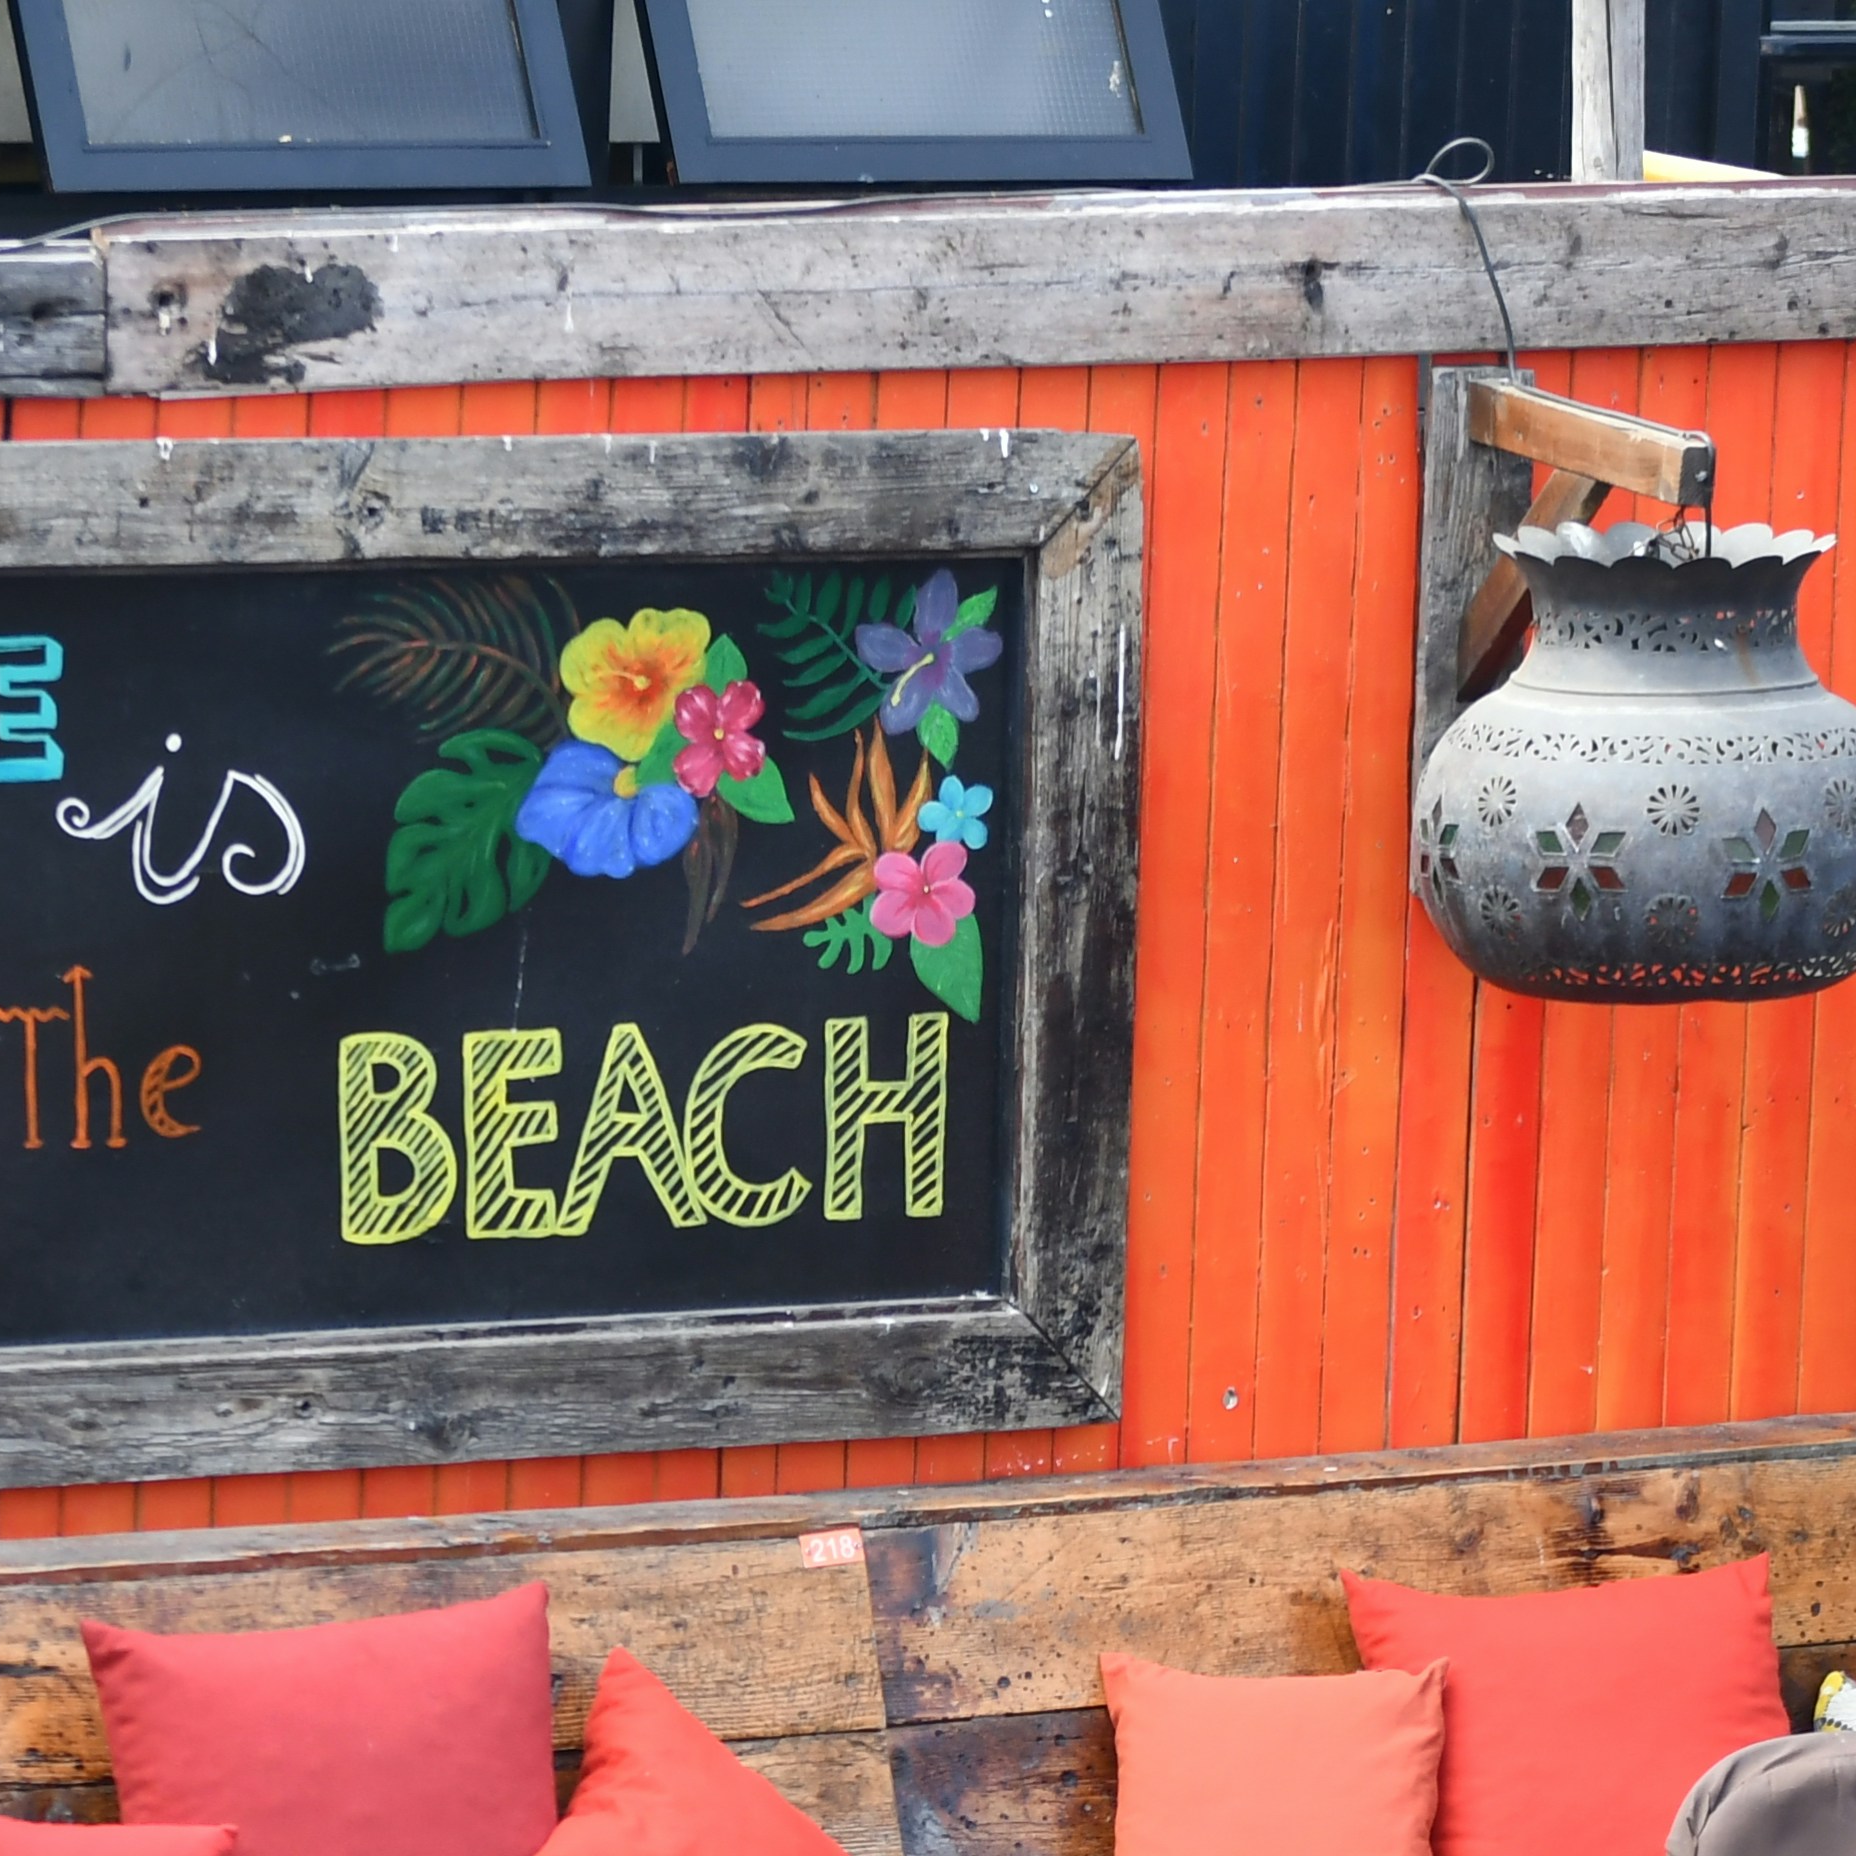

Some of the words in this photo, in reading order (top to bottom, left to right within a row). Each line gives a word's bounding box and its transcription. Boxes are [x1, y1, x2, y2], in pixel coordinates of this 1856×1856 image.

[54, 732, 307, 906] is
[338, 1010, 950, 1246] BEACH
[810, 1534, 855, 1562] 218
